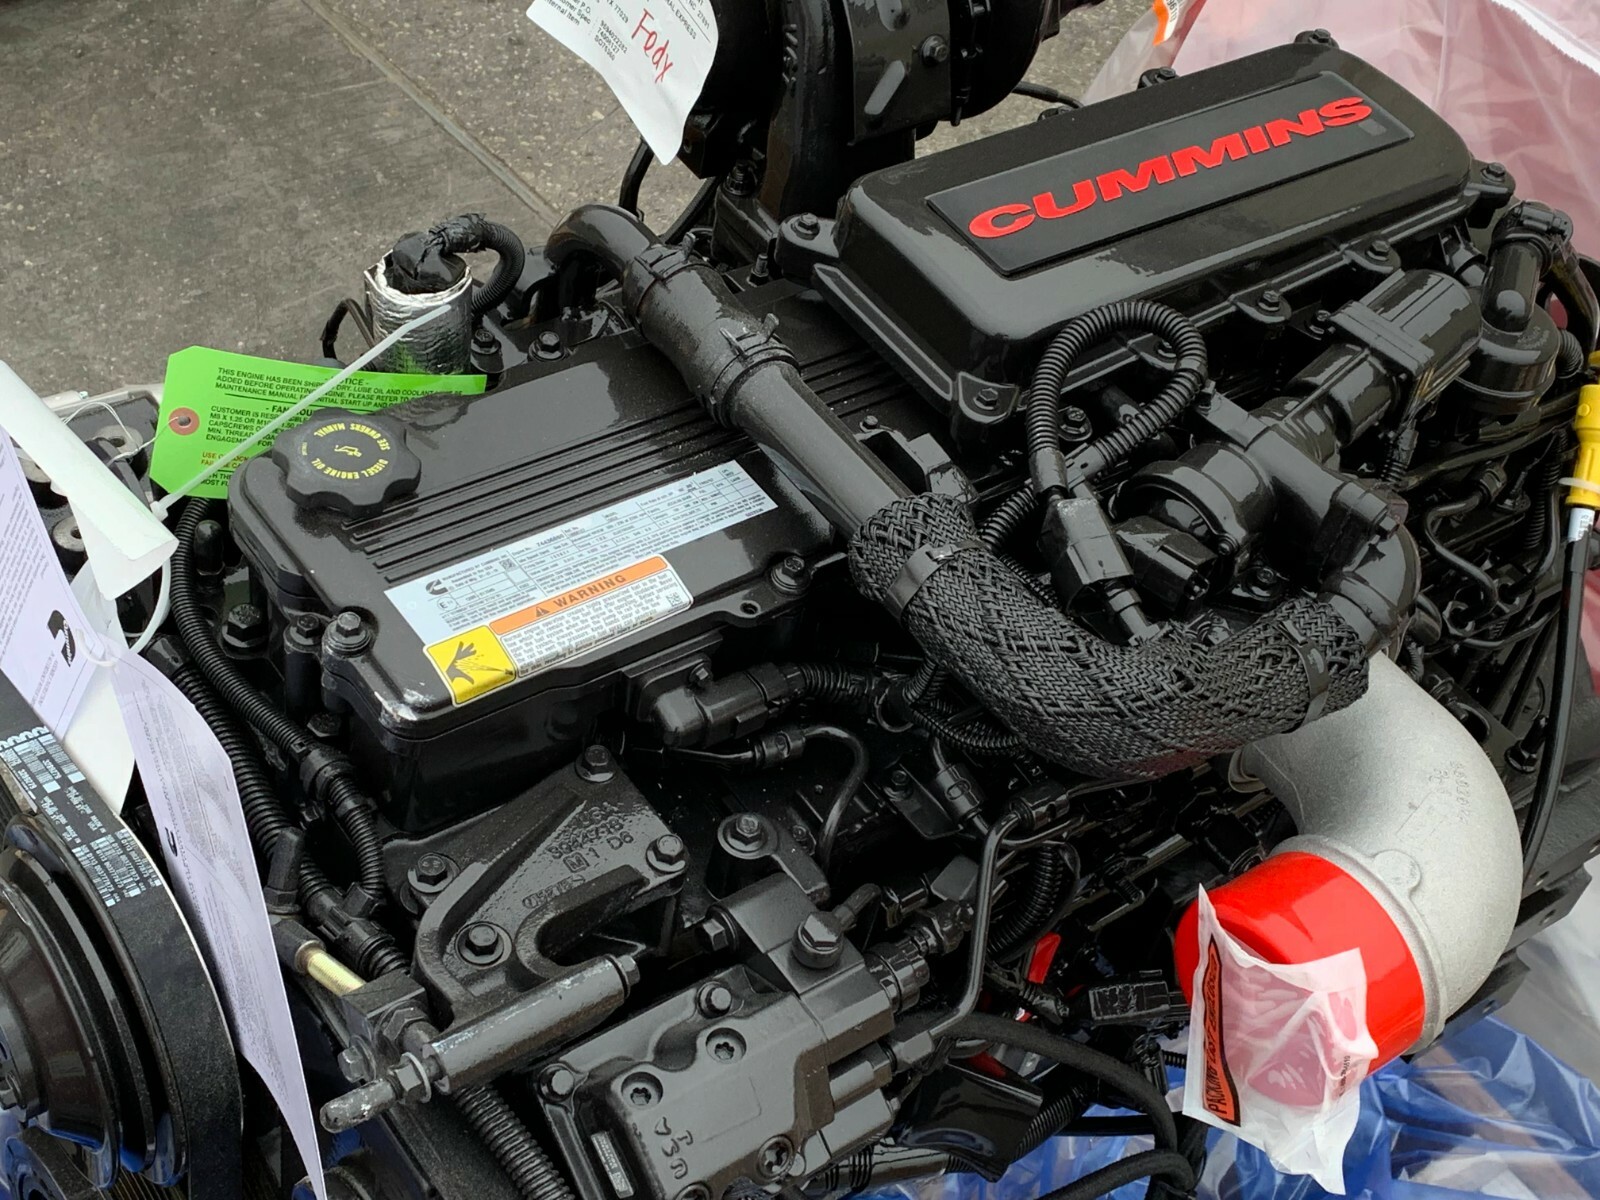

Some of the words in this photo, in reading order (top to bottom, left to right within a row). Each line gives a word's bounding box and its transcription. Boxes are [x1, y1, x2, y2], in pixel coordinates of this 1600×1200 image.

[577, 8, 591, 24] Spec
[675, 11, 696, 40] EXPRESS
[969, 97, 1372, 239] CUMMINS
[216, 375, 243, 384] ADDED
[244, 379, 273, 389] BEFORE
[217, 367, 235, 375] THIS
[236, 370, 264, 380] ENGINE
[266, 374, 280, 382] HAS
[282, 377, 302, 385] BEEN
[215, 382, 266, 395] MAINTENANCE
[268, 389, 298, 399] MANUAL
[340, 397, 362, 406] START
[362, 399, 373, 407] UP
[210, 405, 250, 416] CUSTOMER
[208, 419, 254, 431] CAPSCREWS
[313, 422, 345, 437] MANUAL
[225, 429, 253, 438] THREAD
[376, 437, 390, 450] SEE
[310, 457, 325, 469] OIL
[360, 458, 388, 477] DIESEL
[323, 466, 359, 479] ENGINE
[552, 572, 626, 609] WARNING
[1205, 1064, 1227, 1113] PACKING
